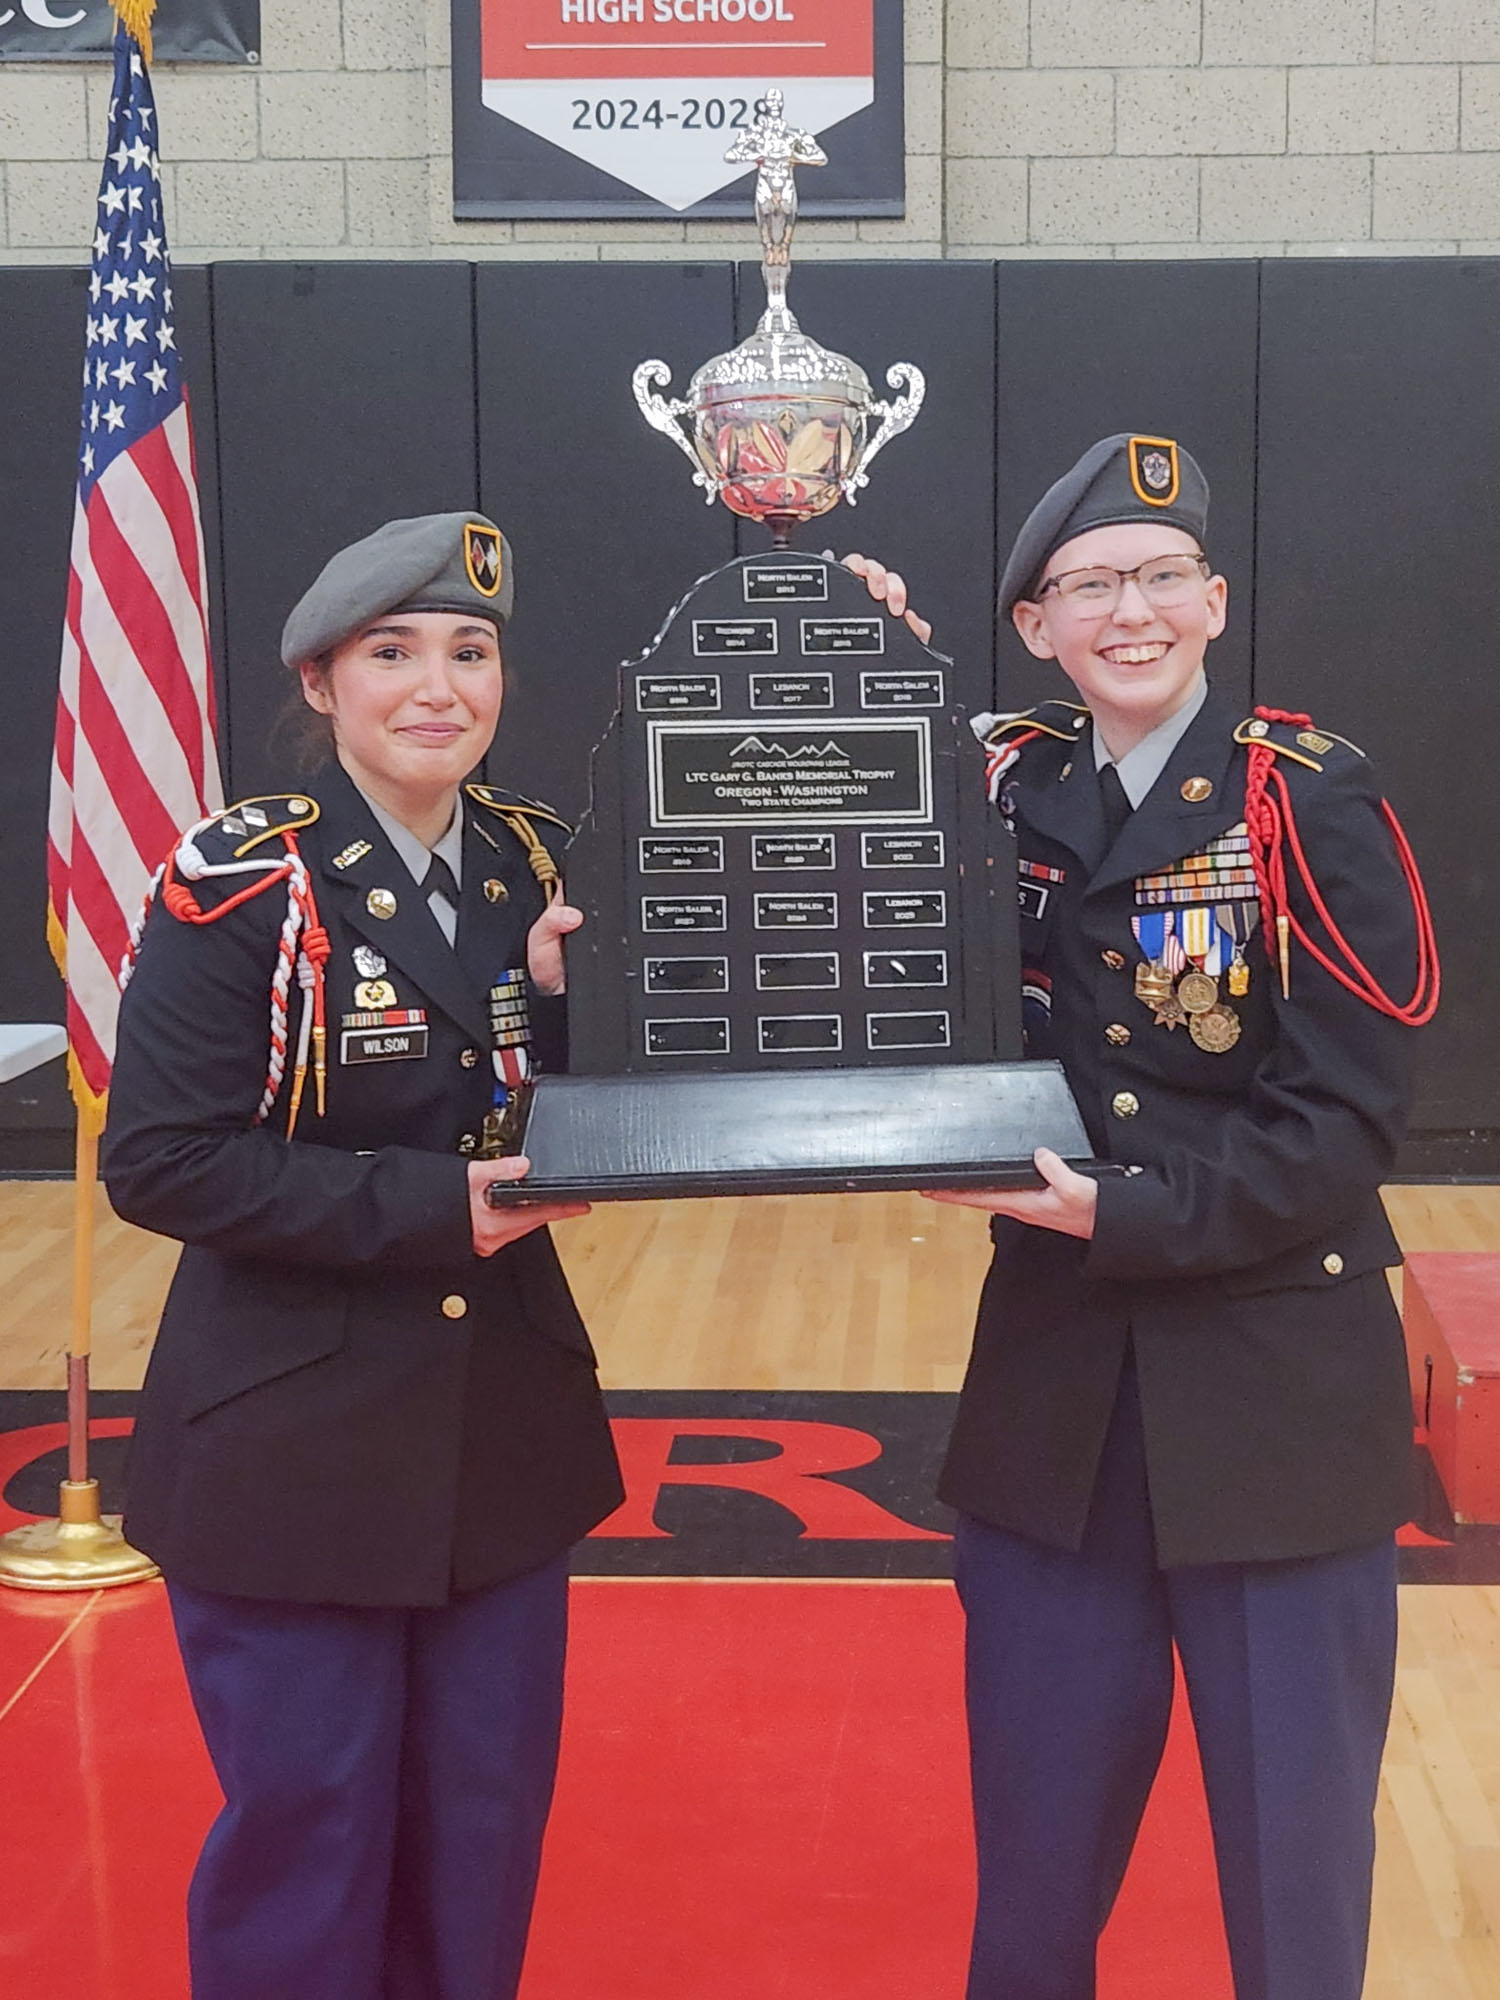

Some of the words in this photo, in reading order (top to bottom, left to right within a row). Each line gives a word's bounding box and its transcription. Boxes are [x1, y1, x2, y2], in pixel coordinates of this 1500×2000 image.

[560, 0, 645, 23] HIGH
[653, 0, 795, 23] SCHOOL
[757, 573, 786, 582] NORTH
[786, 573, 814, 582] SALEM
[813, 627, 842, 636] NORTH
[842, 626, 870, 635] SALEM
[650, 684, 679, 693] NORTH
[679, 683, 707, 692] SALEM
[772, 683, 811, 692] LEBANON
[874, 682, 903, 691] NORTH
[903, 681, 930, 690] SALEM
[685, 772, 709, 783] LTC
[710, 771, 740, 783] GARY
[741, 771, 755, 782] G.
[756, 771, 794, 782] BANKS
[795, 769, 852, 781] MEMORIAL
[852, 768, 896, 780] TROPHY
[741, 798, 762, 807] TWO
[762, 798, 790, 807] STATE
[791, 796, 844, 806] CHAMPIONS
[654, 846, 682, 854] NORTH
[683, 846, 710, 854] SALEM
[766, 843, 794, 853] NORTH
[794, 843, 822, 852] SALEM
[883, 841, 923, 849] LEBANON
[768, 902, 797, 911] NORTH
[797, 902, 824, 910] SALEM
[885, 898, 924, 907] LEBANON
[656, 905, 685, 914] NORTH
[685, 905, 713, 914] SALEM
[363, 1037, 410, 1055] WILSON
